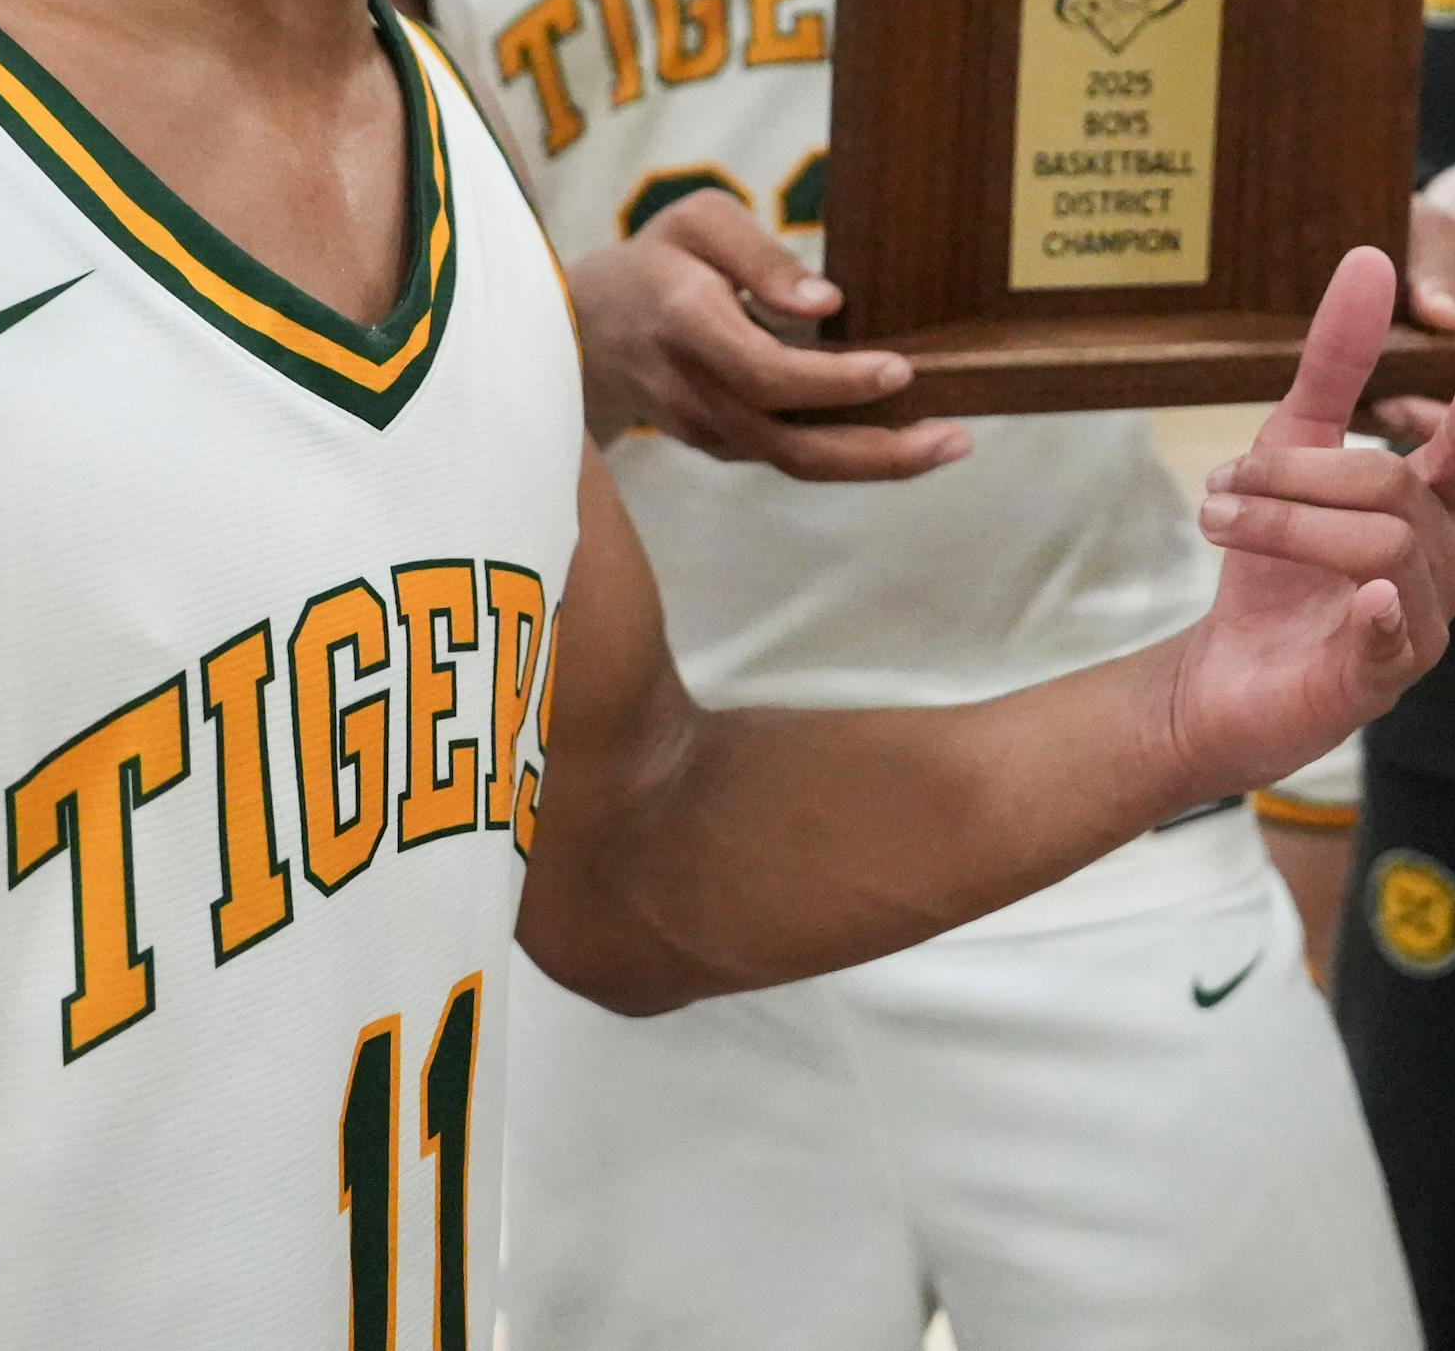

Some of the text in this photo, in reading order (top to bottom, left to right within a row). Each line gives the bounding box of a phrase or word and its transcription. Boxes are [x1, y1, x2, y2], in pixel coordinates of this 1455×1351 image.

[1083, 110, 1150, 137] BOYS
[1034, 149, 1196, 178] BASKETBALL
[1053, 188, 1172, 220] DISTRICT
[1043, 228, 1182, 259] CHAMPION
[338, 969, 483, 1351] 11
